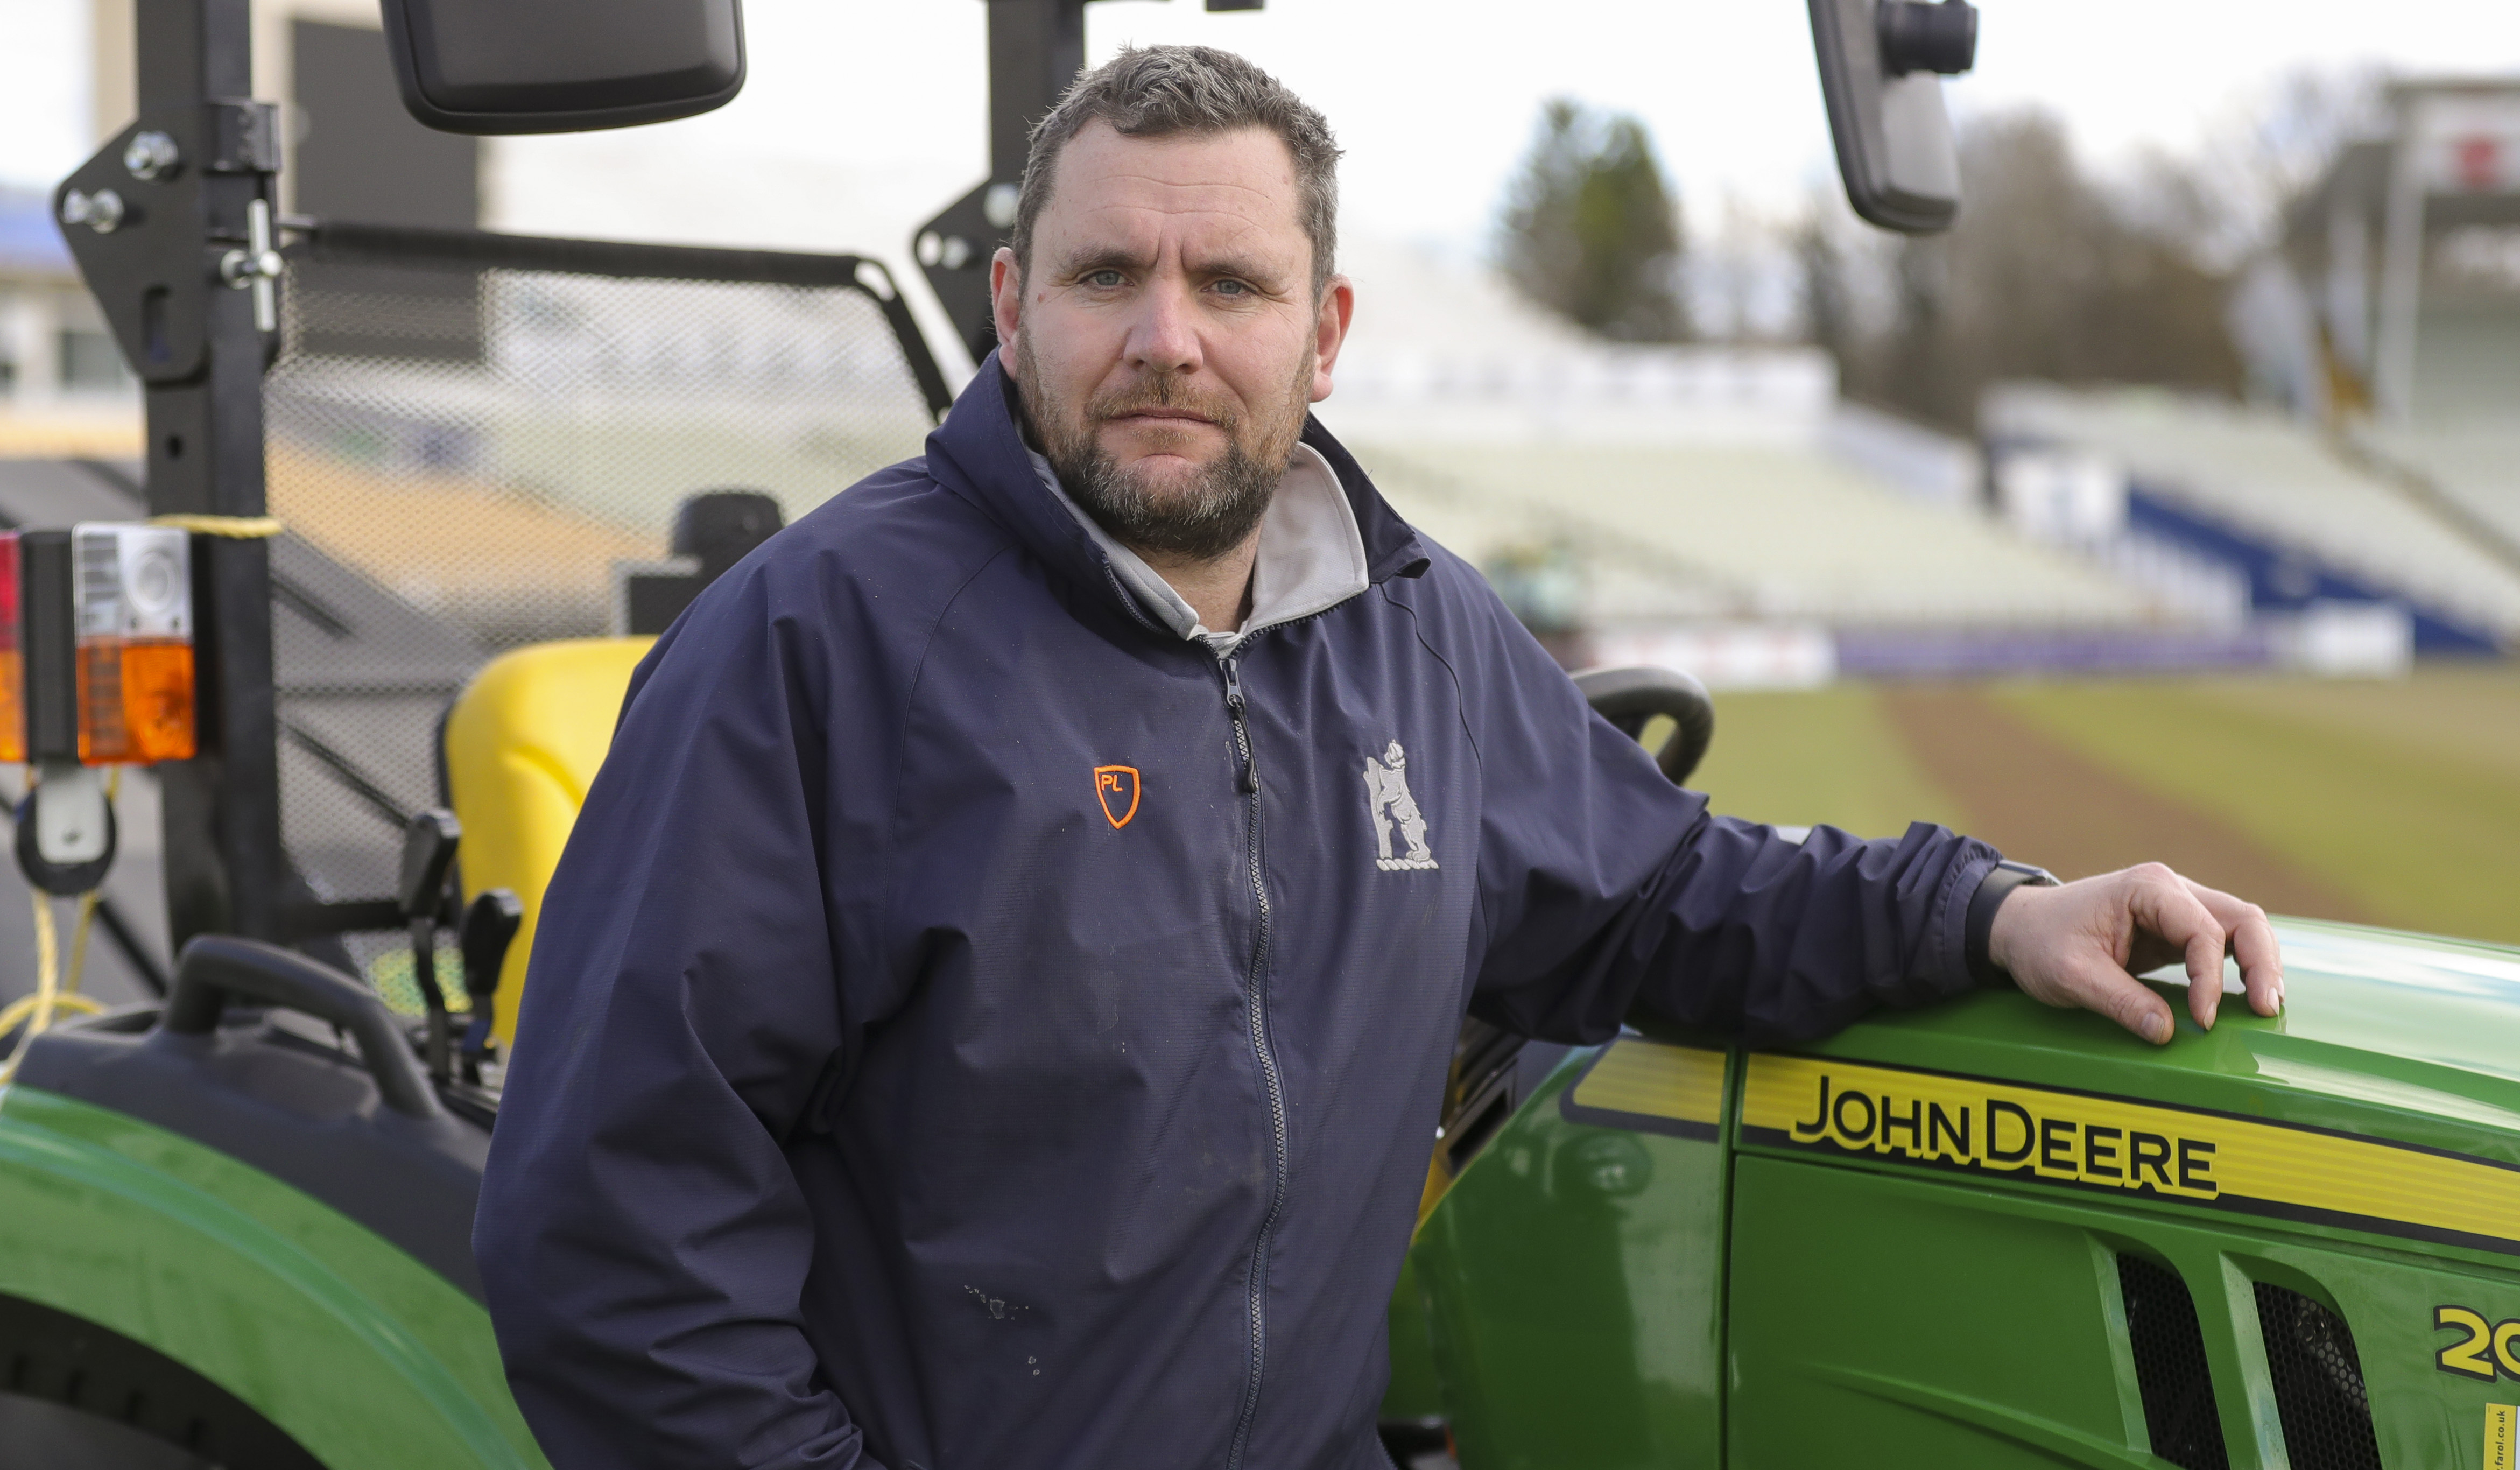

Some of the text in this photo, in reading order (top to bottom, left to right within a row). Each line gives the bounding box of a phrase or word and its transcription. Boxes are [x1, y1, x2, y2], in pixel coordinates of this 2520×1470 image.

[1101, 774, 1123, 792] PL
[1794, 1074, 2218, 1193] JOHN DEERE
[2495, 1410, 2506, 1470] .farol.co.uk
